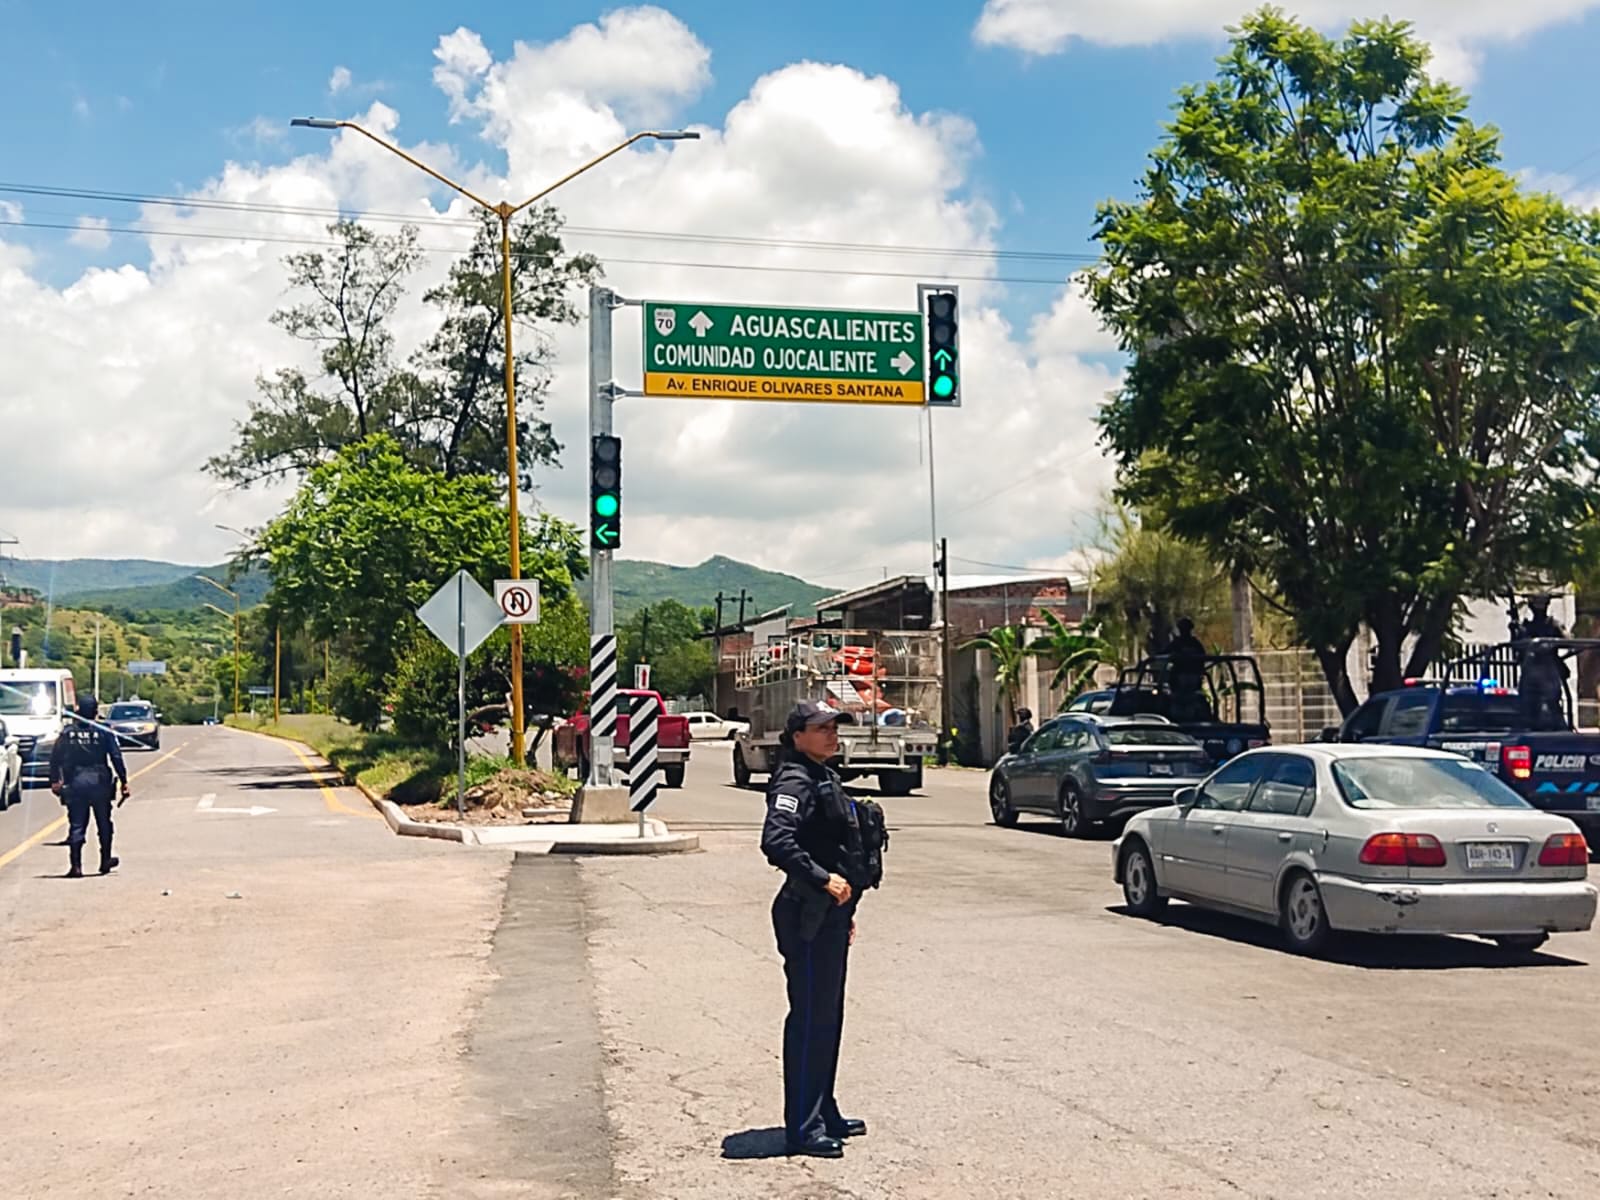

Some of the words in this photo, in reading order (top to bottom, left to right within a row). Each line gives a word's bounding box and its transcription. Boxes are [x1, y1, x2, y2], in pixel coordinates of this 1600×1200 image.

[657, 318, 673, 329] 70
[730, 314, 915, 343] AGUASCALIENTES
[654, 343, 755, 368] COMUNIDAD
[763, 348, 878, 373] OJOCALIENTE
[666, 378, 687, 390] Av.
[692, 378, 757, 392] ENRIQUE
[761, 381, 833, 395] OLIVARES
[836, 383, 904, 397] SANTANA
